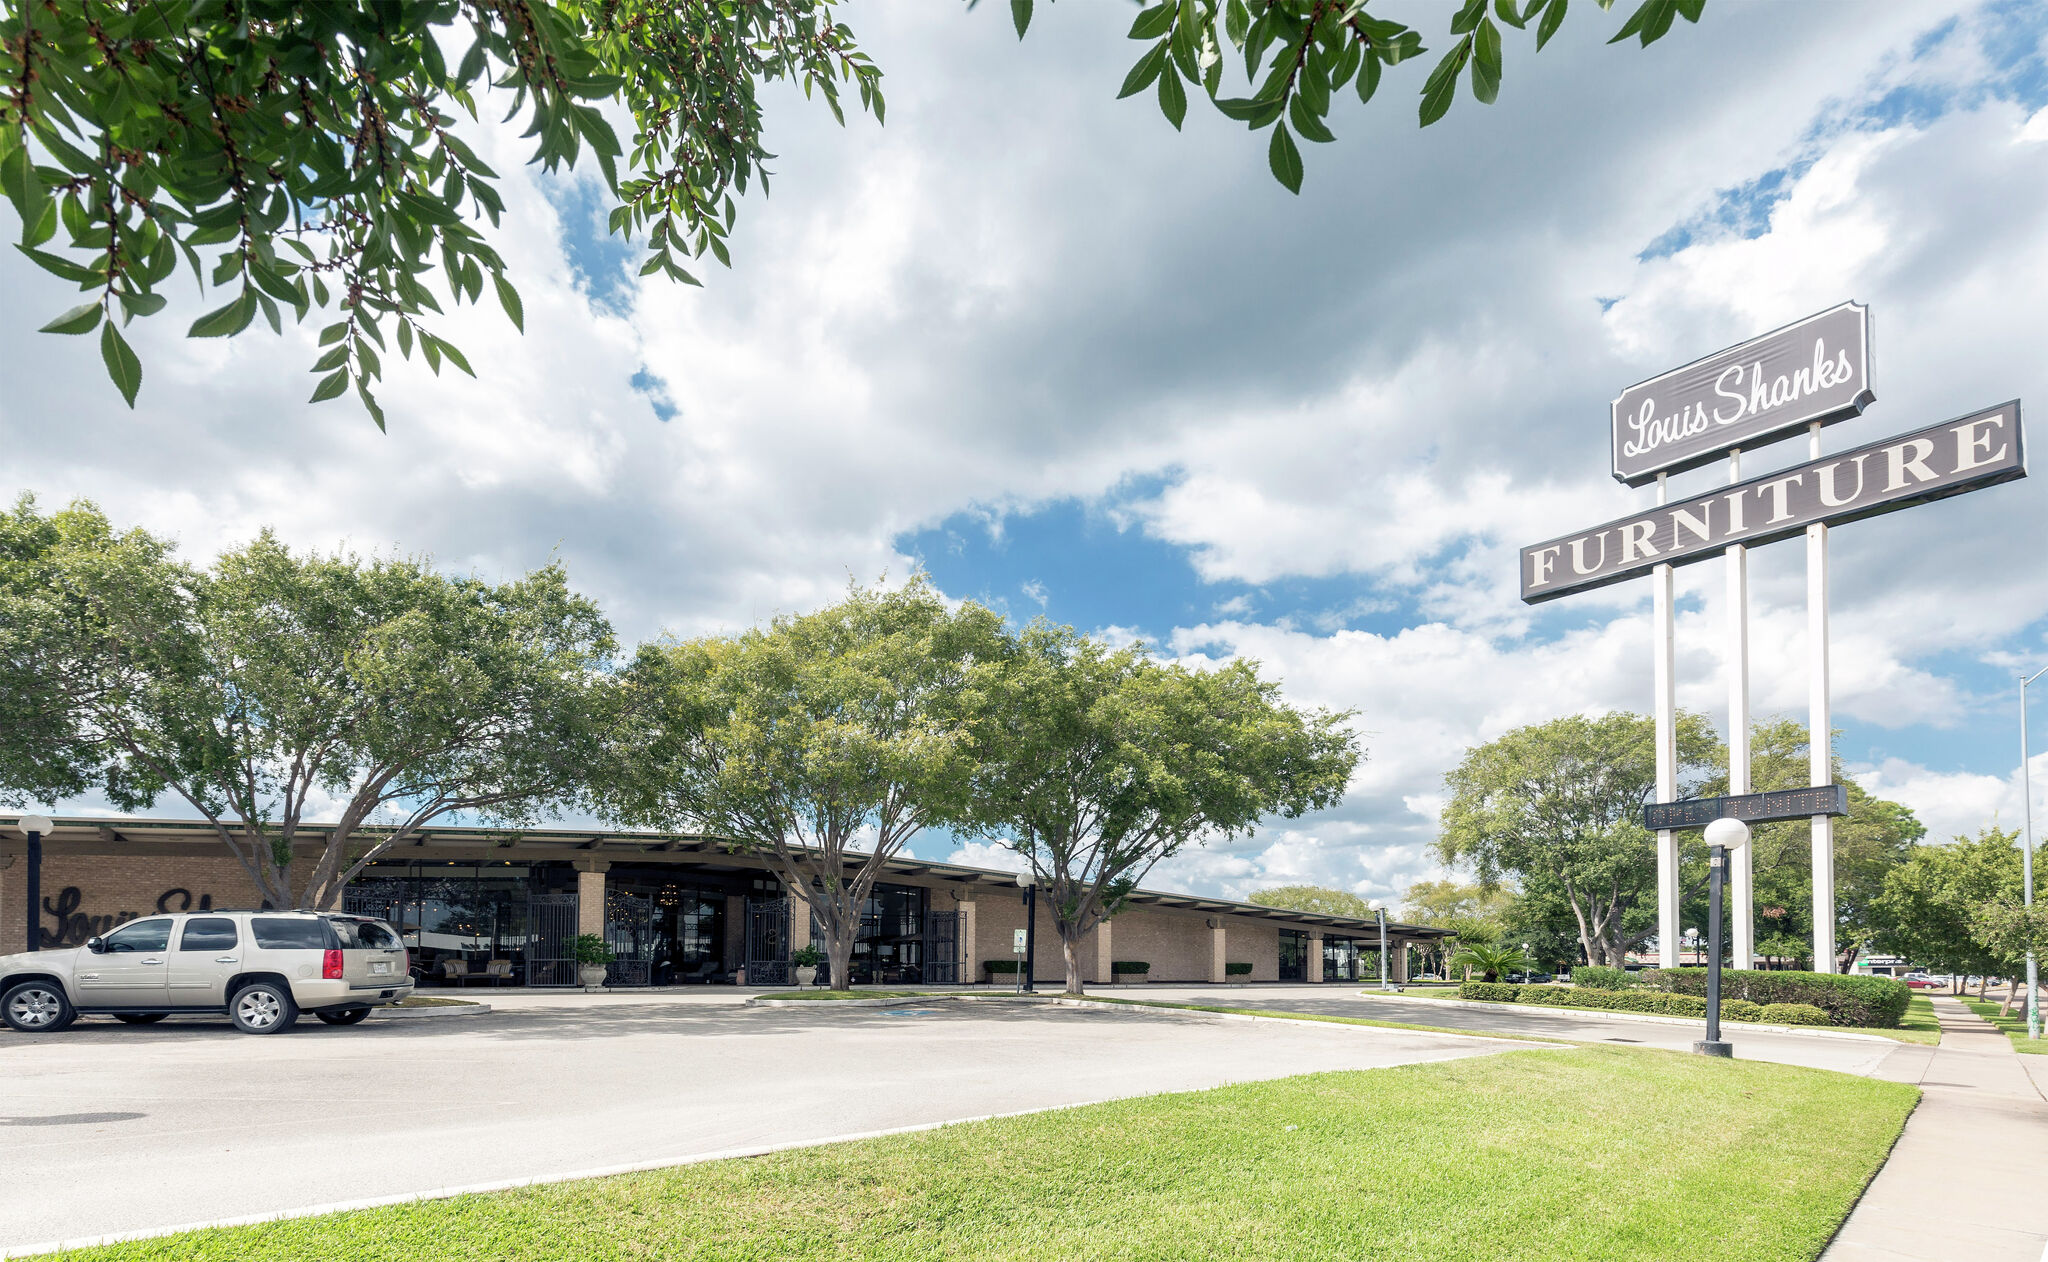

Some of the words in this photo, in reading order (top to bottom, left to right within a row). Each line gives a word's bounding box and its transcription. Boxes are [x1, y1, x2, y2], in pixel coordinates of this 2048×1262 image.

[1624, 398, 1709, 457] Louis
[1713, 337, 1853, 426] Shanks
[1529, 413, 2007, 588] FURNITURE
